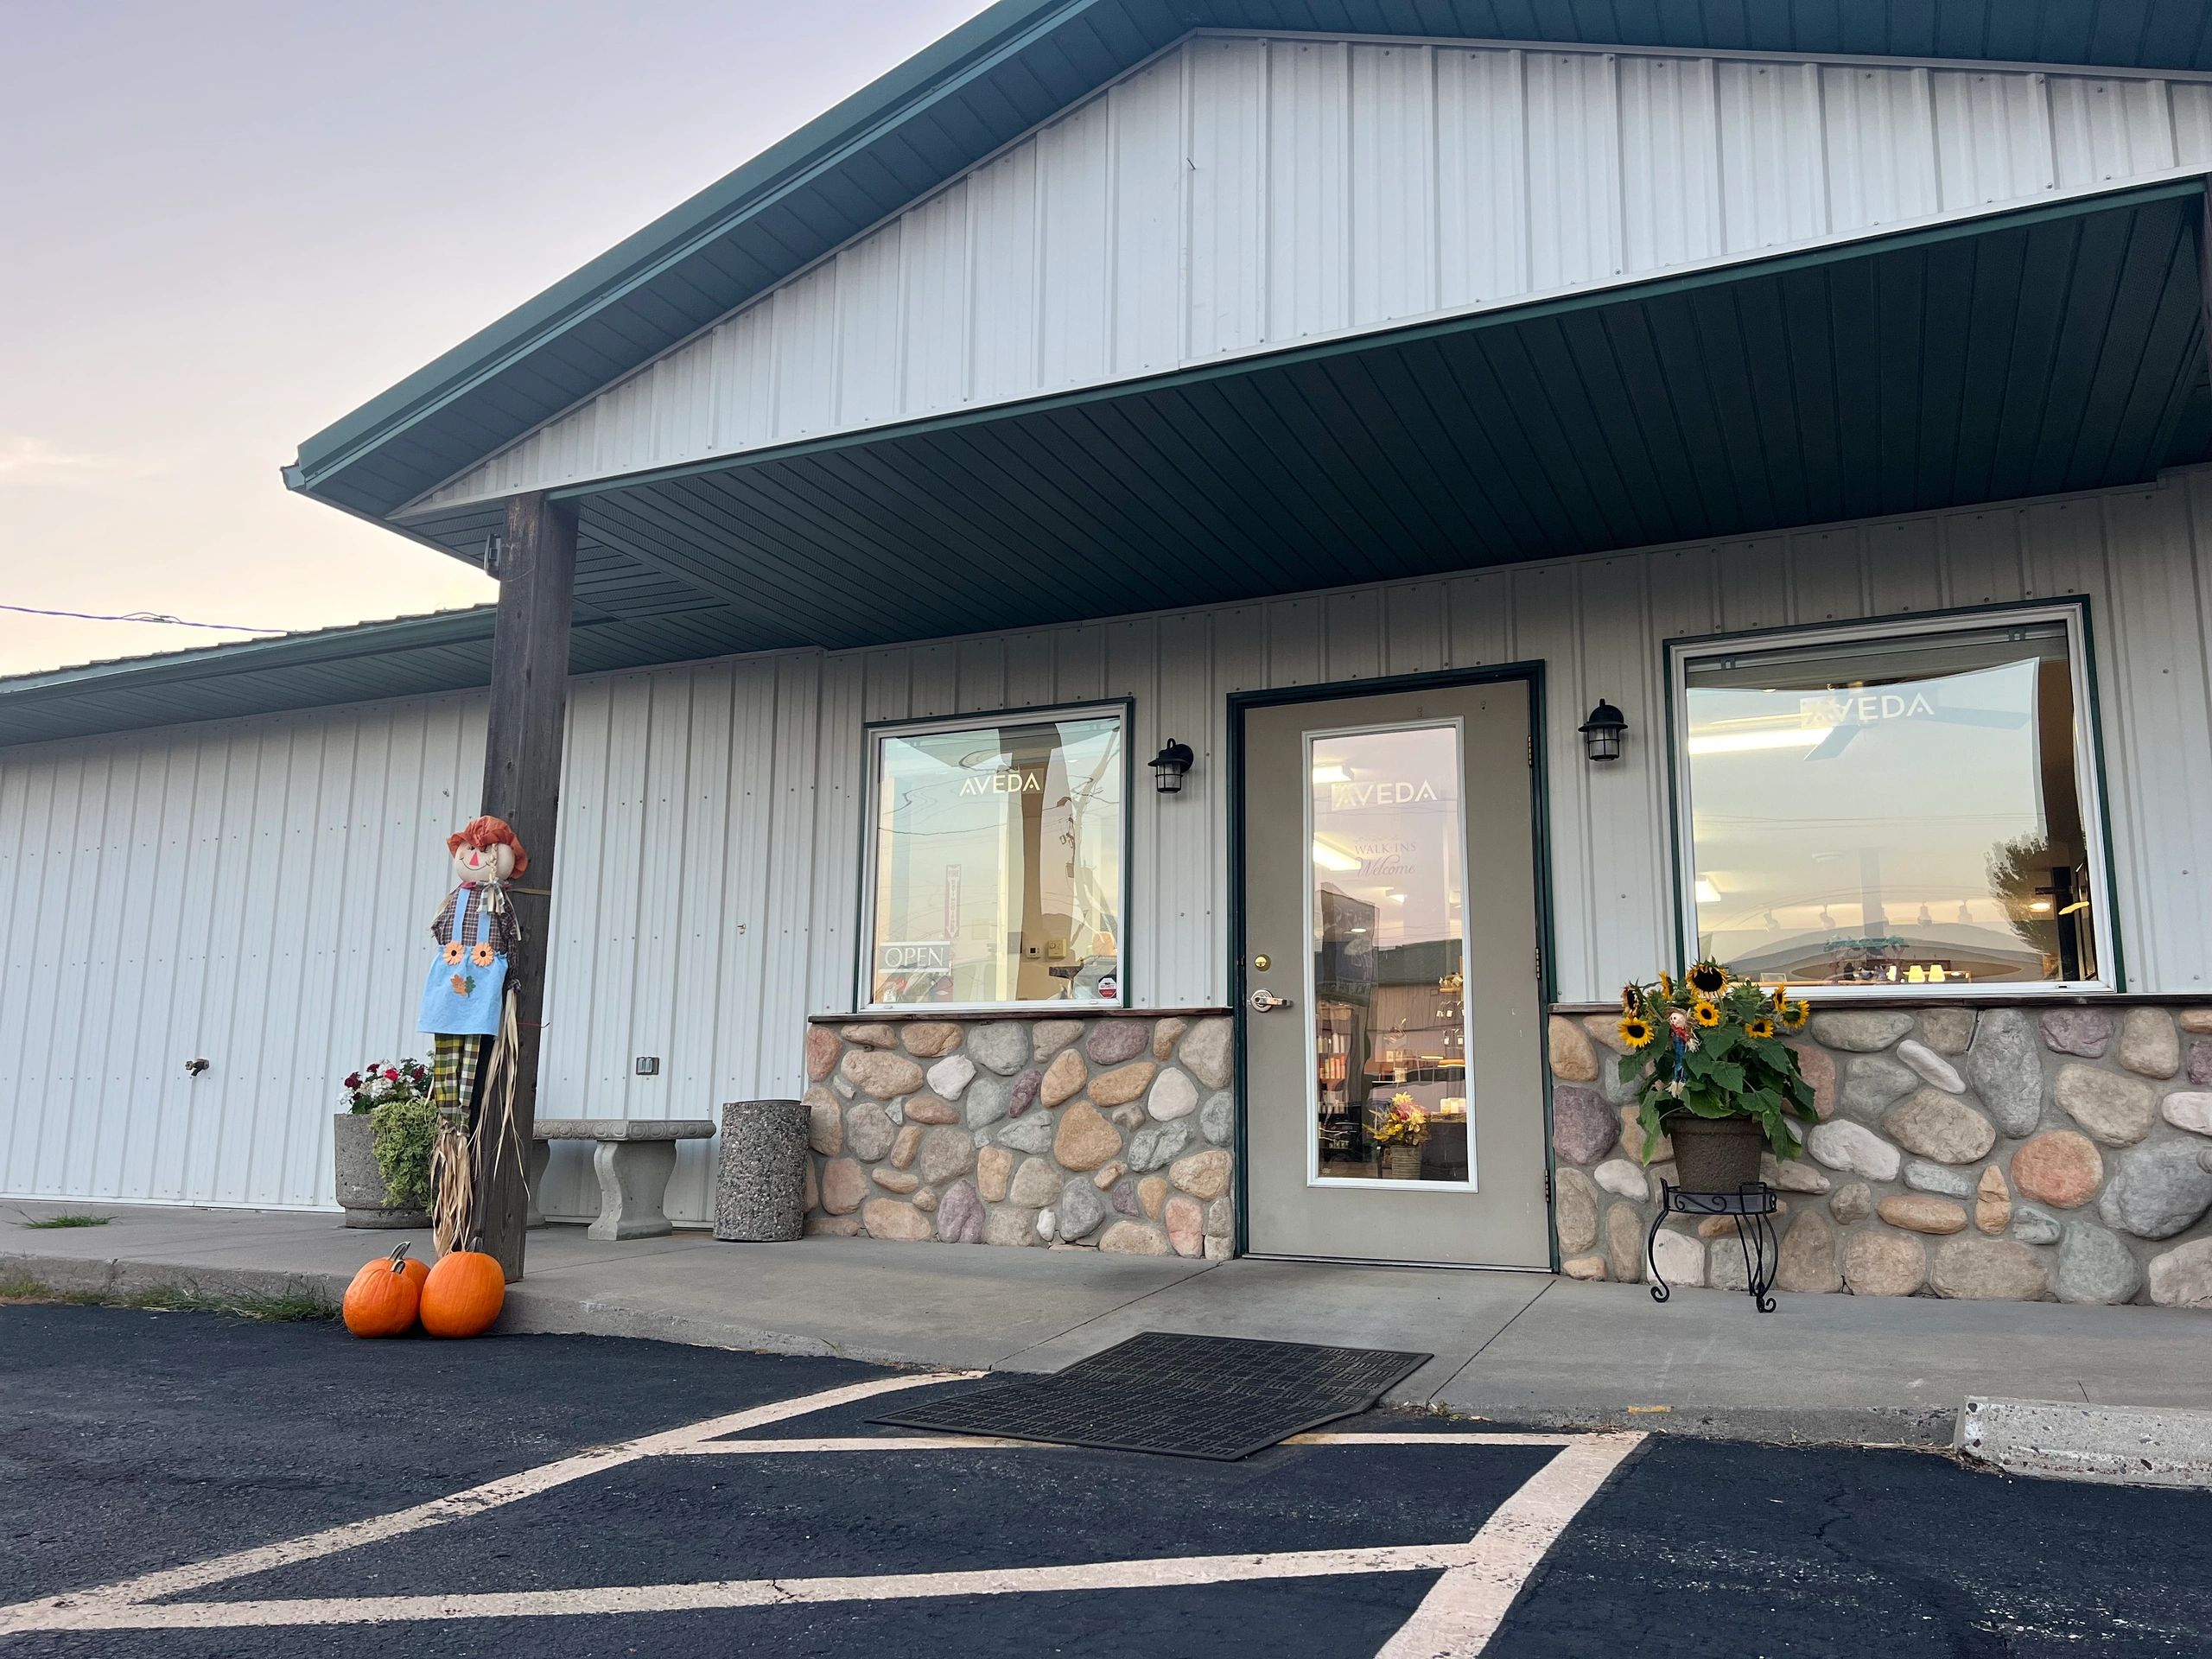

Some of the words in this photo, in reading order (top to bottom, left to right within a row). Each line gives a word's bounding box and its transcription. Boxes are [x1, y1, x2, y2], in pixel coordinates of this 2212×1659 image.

[1807, 692, 1936, 725] AVEDA
[959, 772, 1041, 797] AVEDA
[1335, 780, 1438, 808] AVEDA
[1354, 854, 1417, 878] Welcome
[884, 946, 944, 968] OPEN
